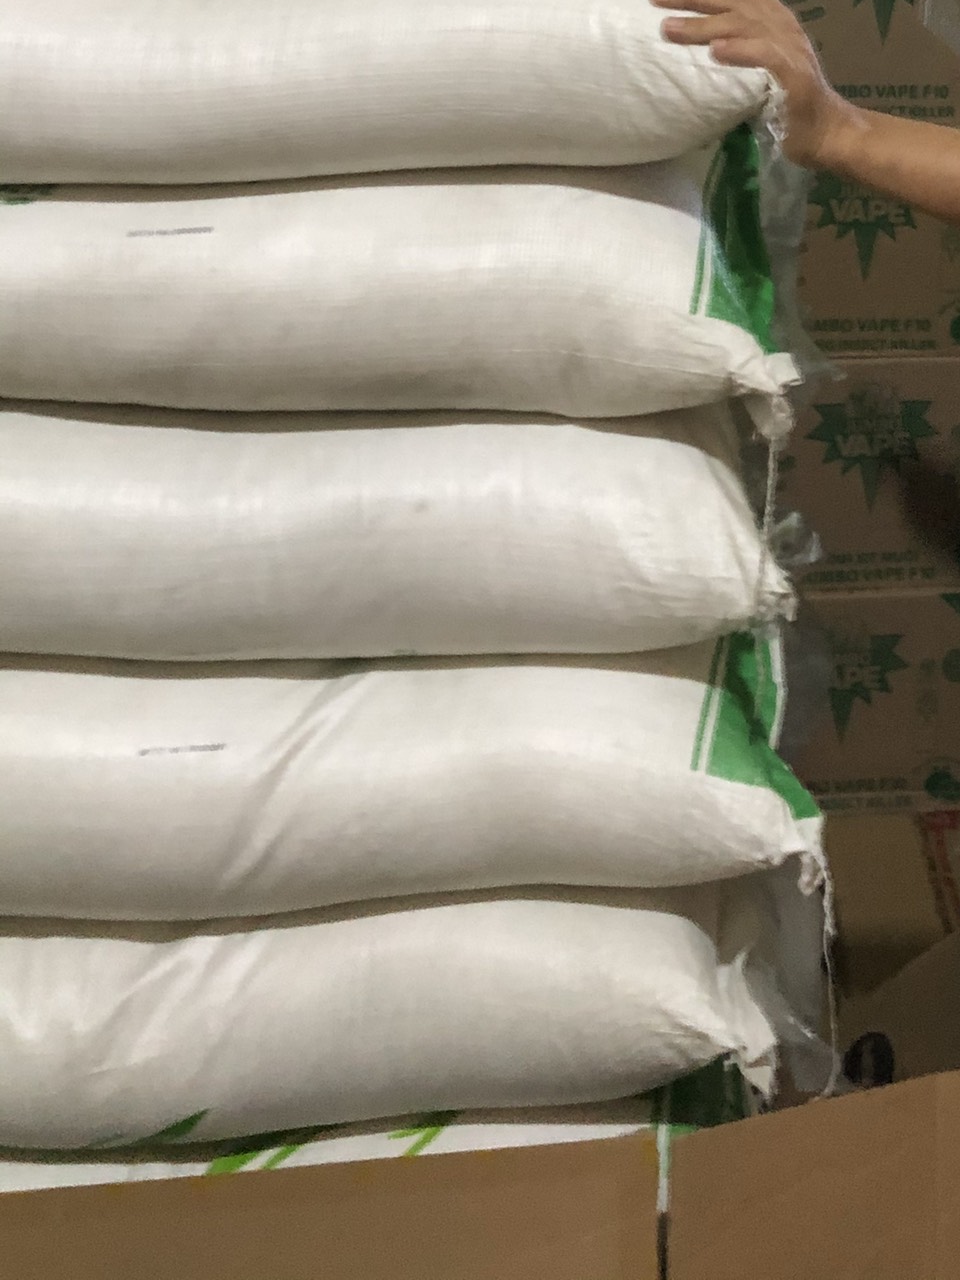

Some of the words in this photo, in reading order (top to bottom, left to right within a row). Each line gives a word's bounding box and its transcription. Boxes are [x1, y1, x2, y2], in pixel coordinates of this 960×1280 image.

[875, 84, 918, 99] VAPE
[828, 197, 908, 223] VAPE
[858, 319, 900, 332] VAPE
